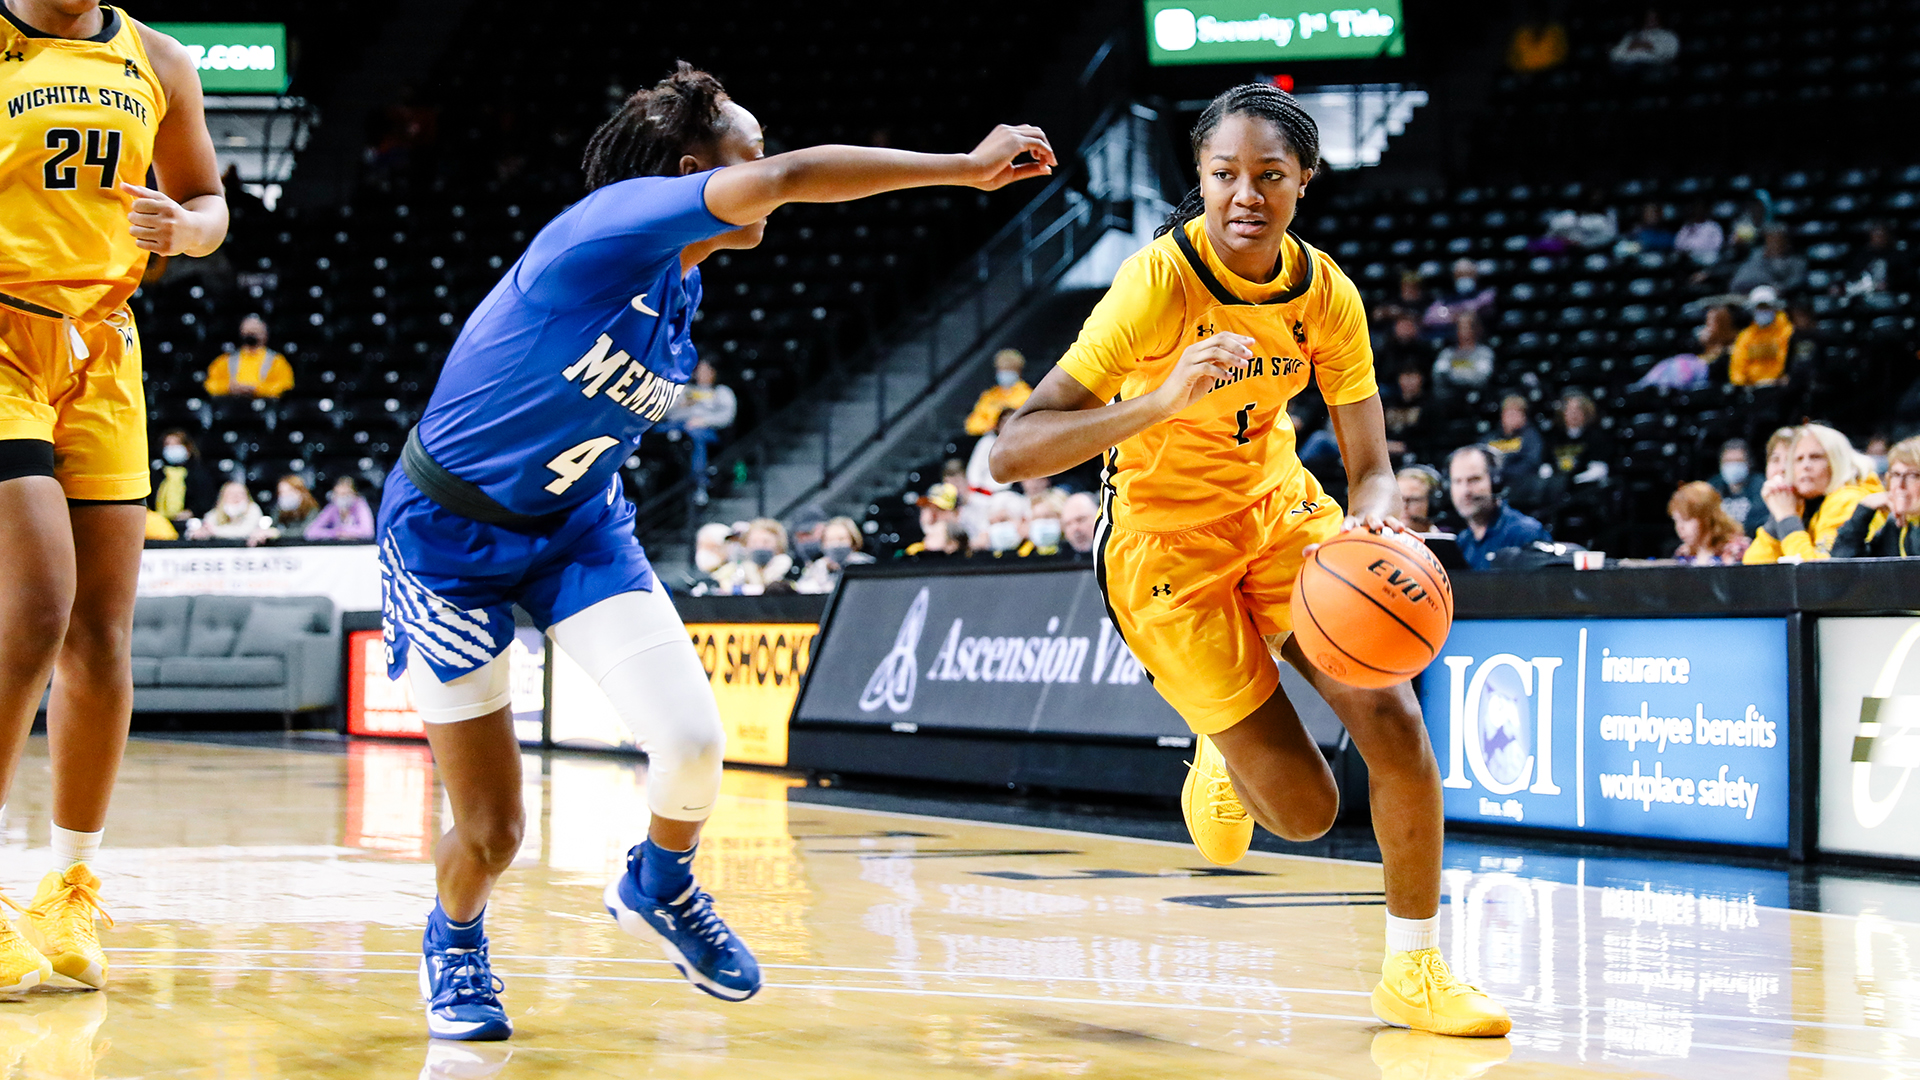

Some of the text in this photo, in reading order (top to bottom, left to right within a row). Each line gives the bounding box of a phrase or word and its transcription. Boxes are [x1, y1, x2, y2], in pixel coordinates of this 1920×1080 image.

[7, 85, 147, 126] WICHITA STATE
[43, 127, 122, 190] 24
[544, 435, 620, 496] 4
[1366, 558, 1428, 604] EVO
[724, 633, 811, 687] SHOCK
[926, 617, 1091, 684] Ascension
[1601, 647, 1691, 685] insurance
[1442, 652, 1564, 796] ICI
[1599, 700, 1778, 754] employee benefits
[1599, 759, 1760, 820] workplace safety
